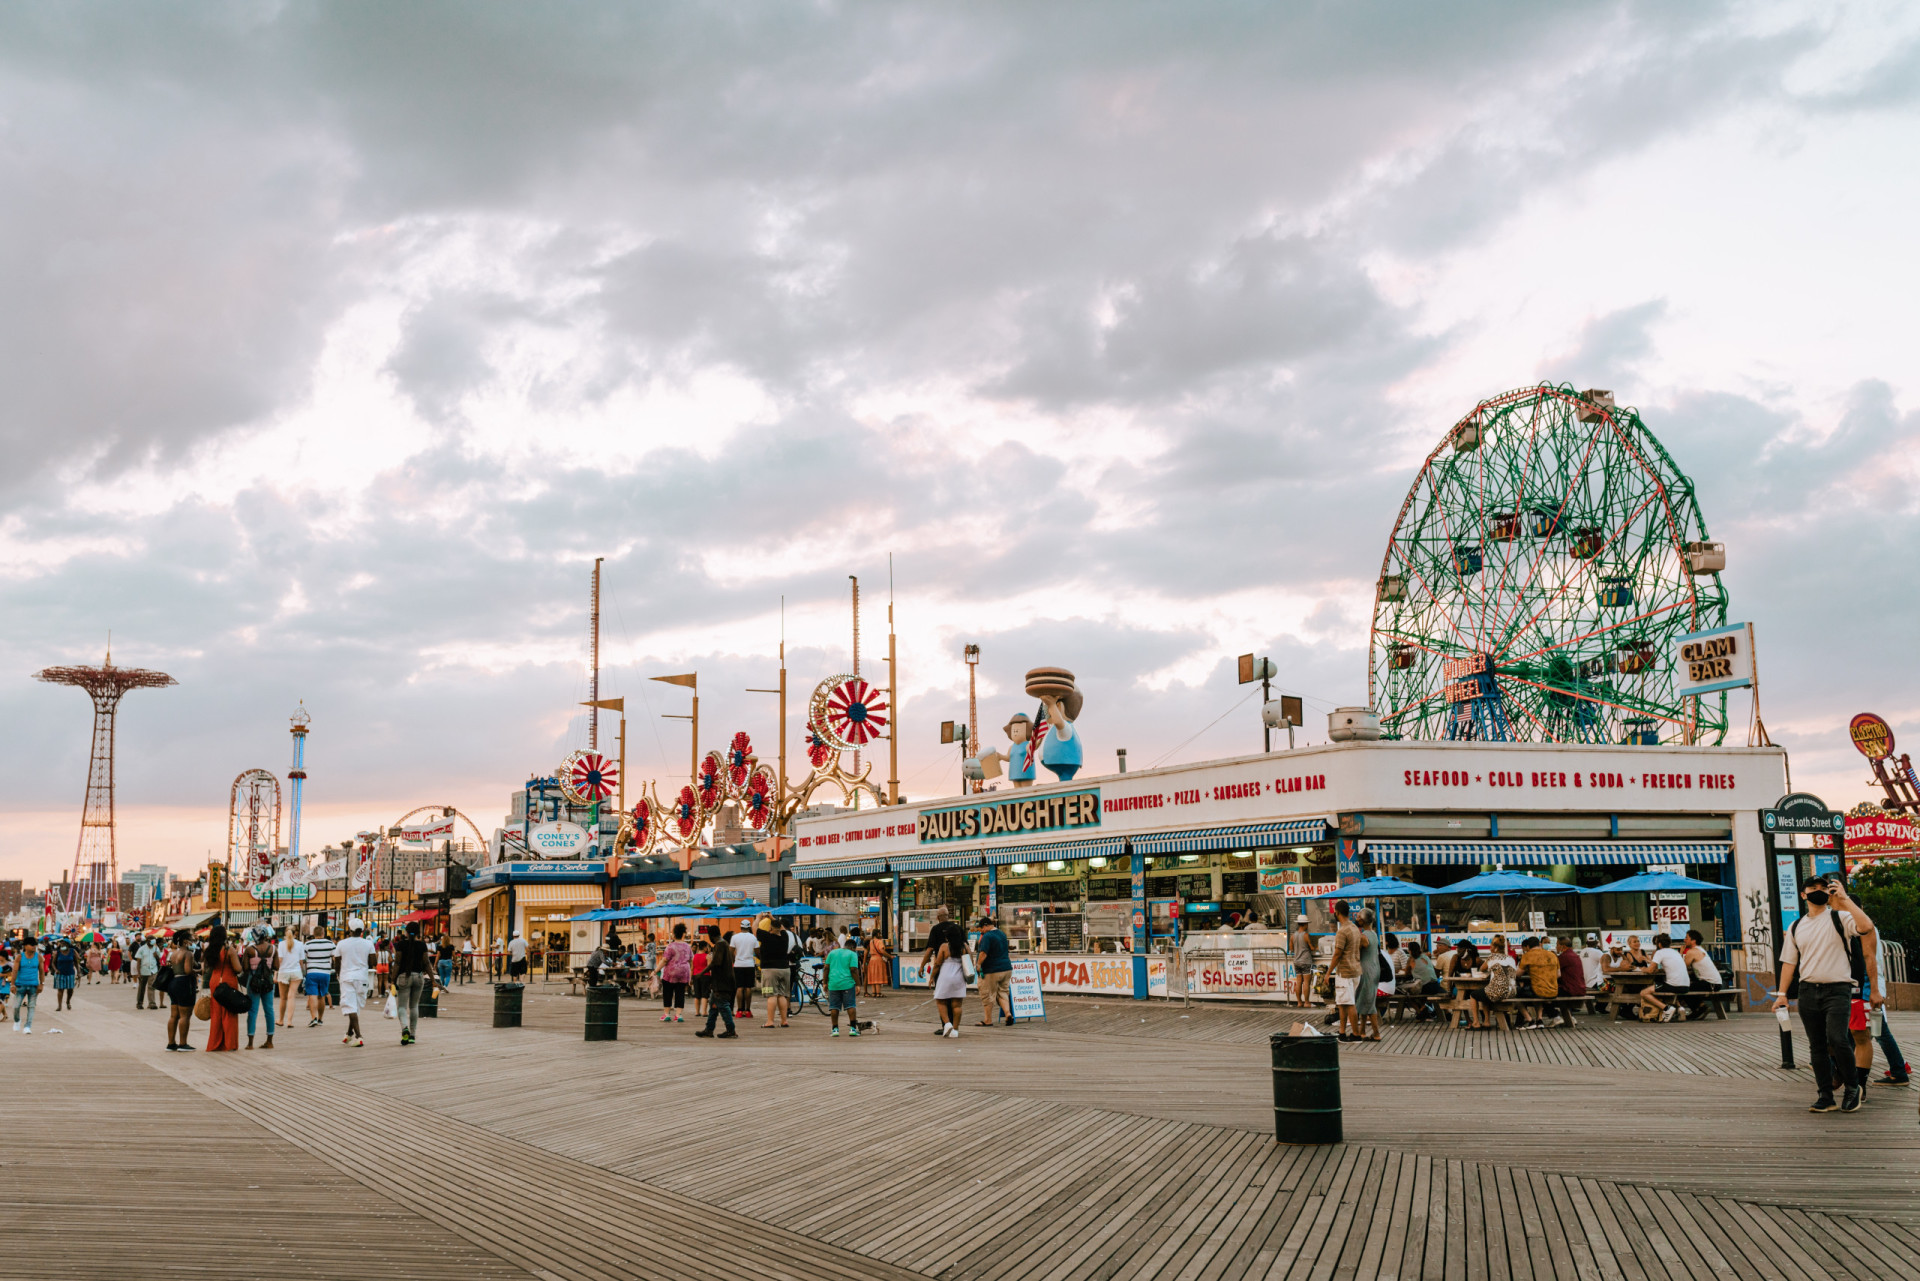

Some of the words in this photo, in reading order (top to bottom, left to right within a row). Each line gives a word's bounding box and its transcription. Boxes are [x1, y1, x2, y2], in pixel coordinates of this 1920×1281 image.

[1681, 636, 1736, 663] CLAM
[1443, 653, 1486, 681] WONDER
[1688, 658, 1733, 682] BAR
[1445, 679, 1484, 703] WHEEL
[1850, 723, 1888, 741] ELECTRO
[1864, 739, 1888, 757] SPIN
[1404, 770, 1470, 787] SEAFOOD
[1489, 771, 1523, 787] COLD
[1531, 772, 1567, 788] BEER
[1574, 773, 1583, 787] &
[1590, 773, 1624, 788] SODA
[1642, 773, 1692, 789] FRENCH
[1699, 774, 1735, 789] FRIES
[1104, 793, 1163, 813] FRANKFURTERS
[1174, 789, 1200, 806] PIZZA
[1213, 781, 1261, 800] SAUSAGES
[1275, 776, 1302, 793] CLAM
[1305, 774, 1326, 790] BAR
[918, 809, 979, 841] PAUL'S
[980, 793, 1099, 834] DAUGHTER
[1777, 816, 1795, 827] West
[1796, 816, 1811, 827] 10th
[1812, 817, 1832, 828] Street
[815, 835, 826, 846] COLD
[828, 833, 840, 843] BEER
[845, 830, 863, 842] COTTON
[865, 827, 881, 840] CANDY
[886, 825, 895, 837] ICE
[897, 823, 916, 836] CREAM
[527, 863, 553, 872] Gelato
[561, 863, 588, 871] Sorbet
[1340, 861, 1360, 873] CLAMS
[1262, 873, 1282, 888] Lobster
[1282, 870, 1298, 884] Rolls
[1286, 885, 1314, 896] CLAM
[1653, 906, 1687, 920] BEER
[1228, 959, 1248, 967] CLAMS
[901, 966, 927, 983] ICE
[1025, 975, 1037, 984] Bar
[1039, 960, 1090, 986] PIZZA
[1091, 960, 1134, 989] Knish
[1202, 970, 1277, 988] SAUSAGE
